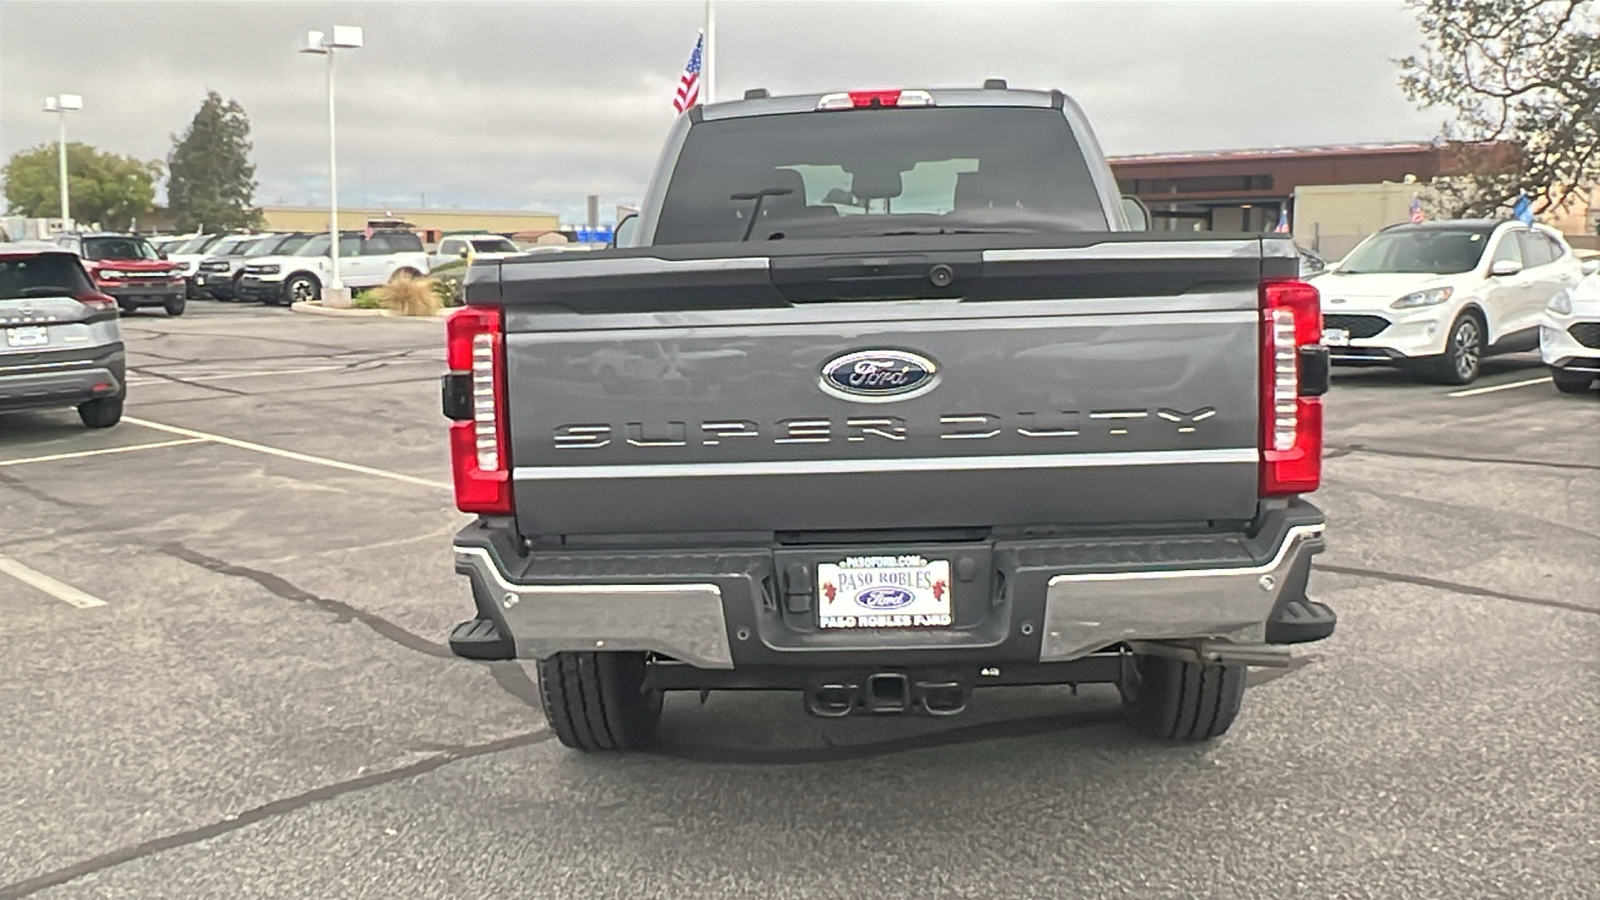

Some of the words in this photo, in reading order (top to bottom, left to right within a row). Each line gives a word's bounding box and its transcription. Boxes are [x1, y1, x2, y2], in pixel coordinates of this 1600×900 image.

[849, 360, 908, 386] Ford
[553, 415, 906, 449] SUPER
[940, 406, 1216, 439] DUTY
[838, 572, 873, 593] PASO
[879, 570, 932, 590] ROBLES
[867, 590, 904, 606] Ford
[820, 616, 857, 629] PASO
[858, 615, 911, 628] ROBLES
[914, 614, 951, 627] FORD
